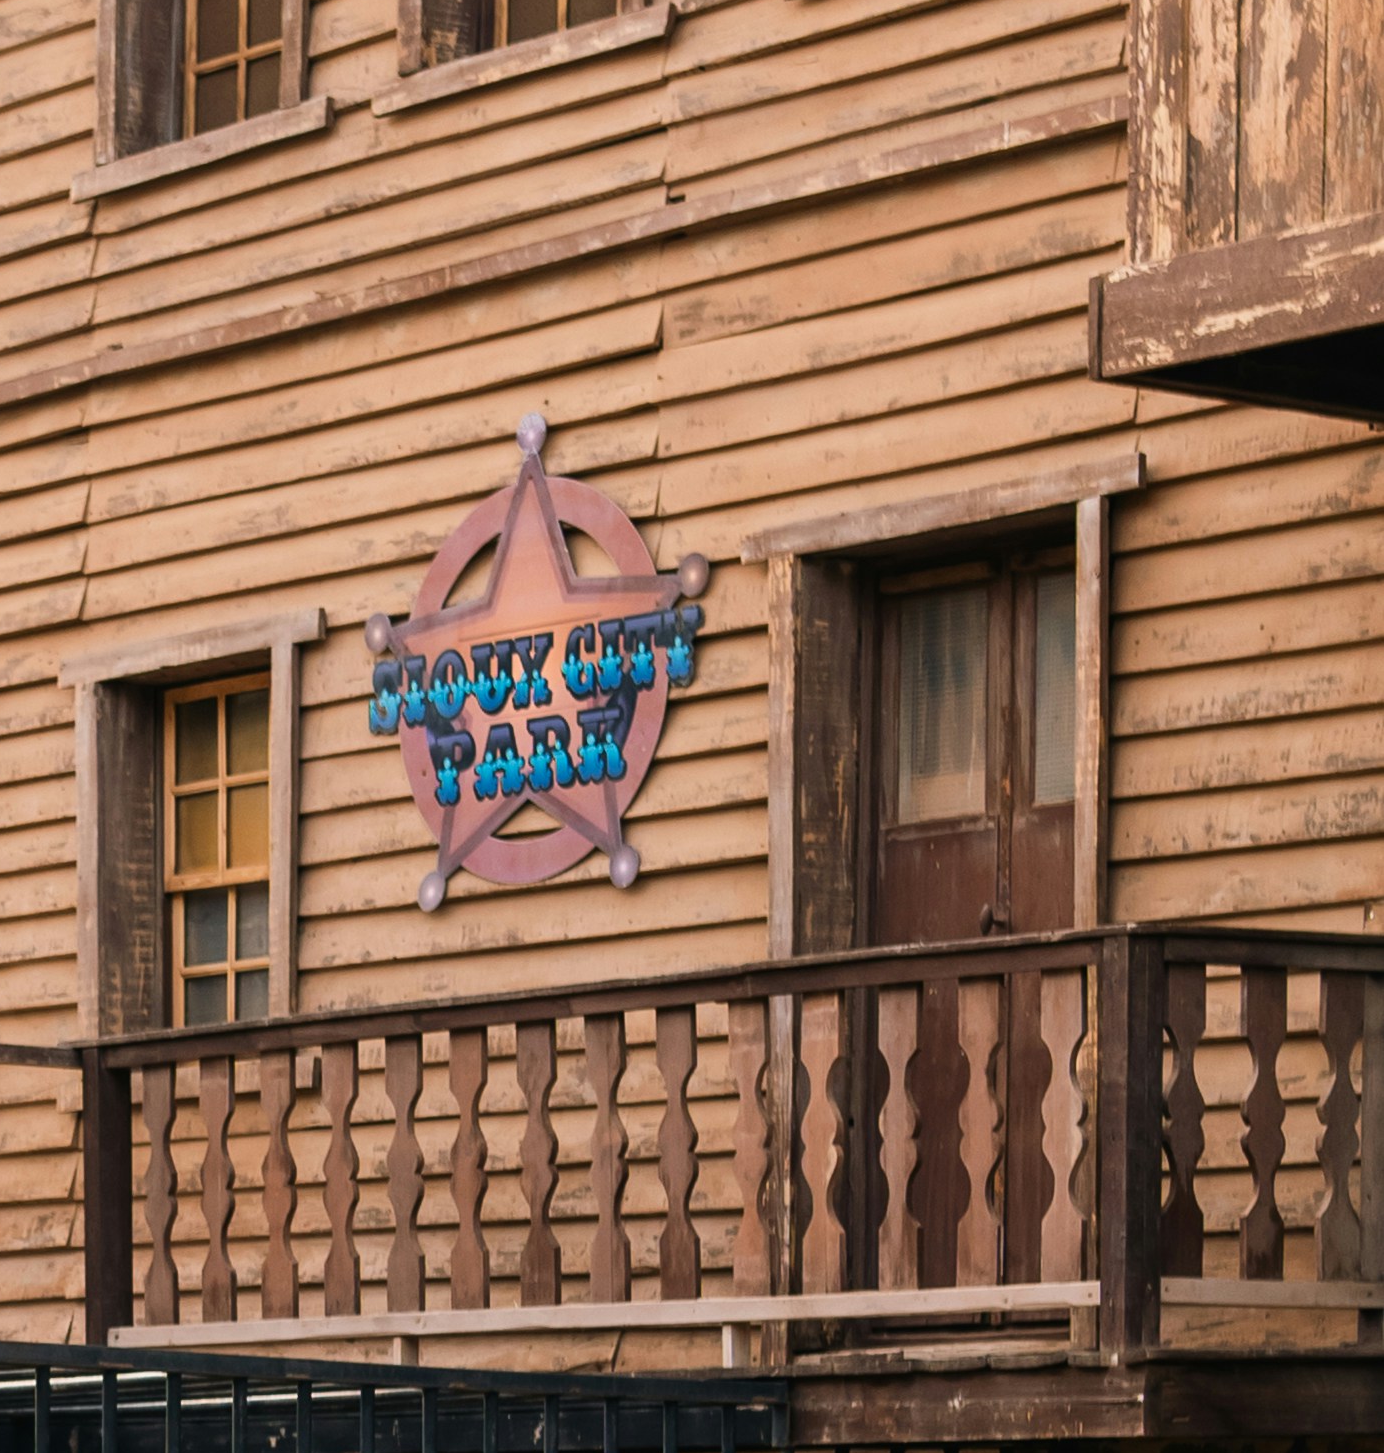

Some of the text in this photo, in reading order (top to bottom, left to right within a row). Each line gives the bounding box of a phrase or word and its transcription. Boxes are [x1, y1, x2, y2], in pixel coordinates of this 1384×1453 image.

[368, 604, 706, 735] SIOUX CITY
[430, 704, 627, 807] PARK
